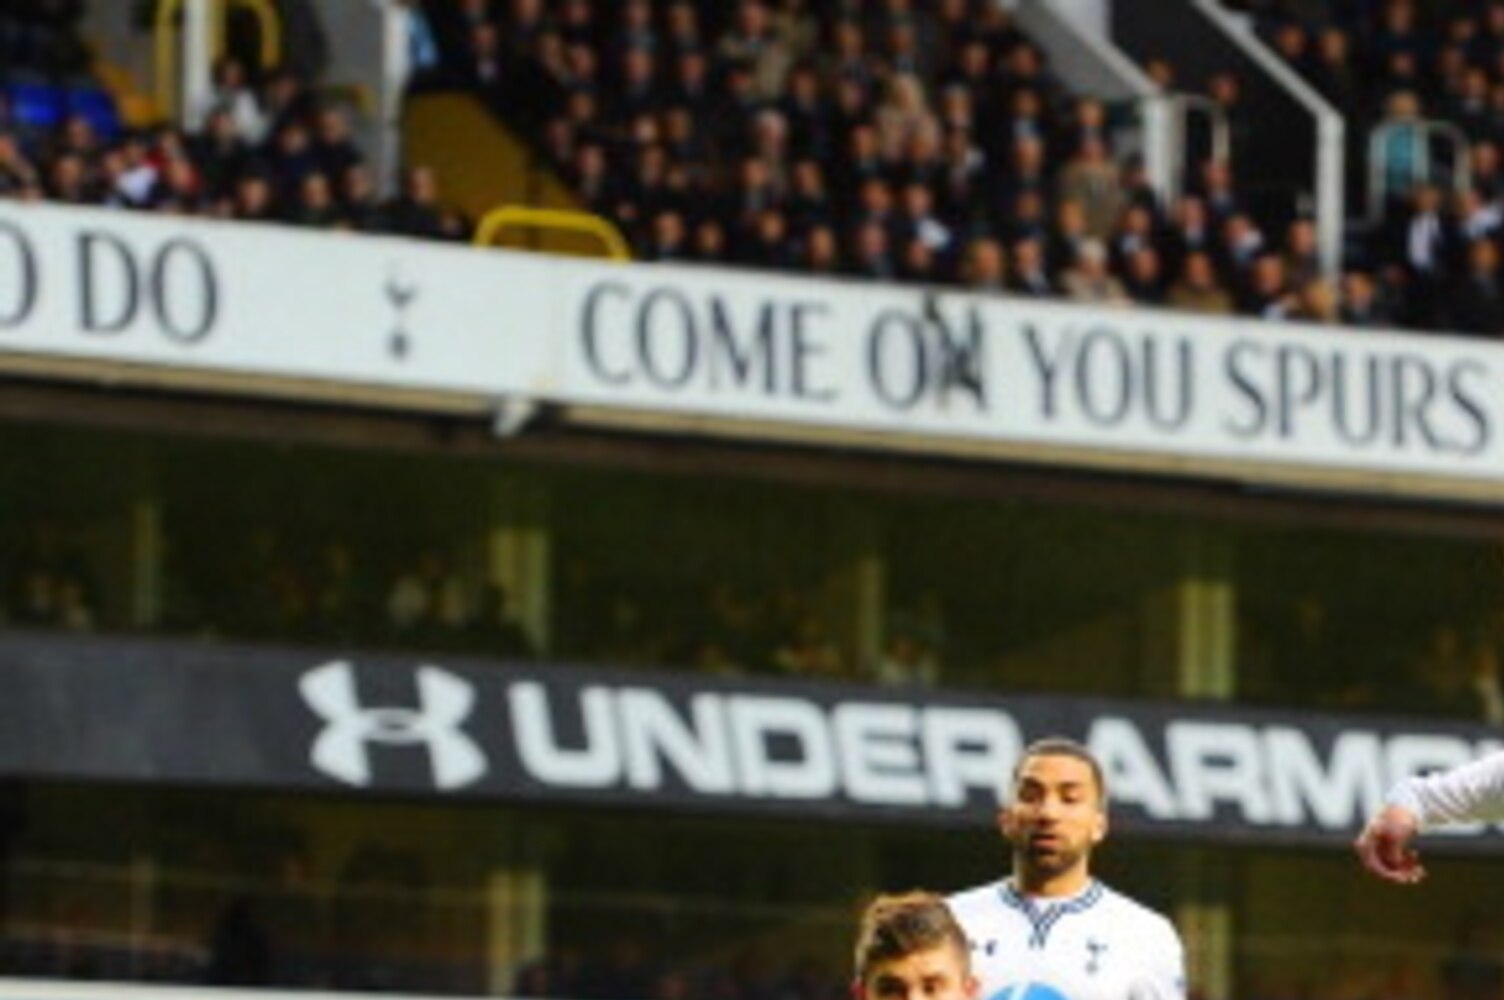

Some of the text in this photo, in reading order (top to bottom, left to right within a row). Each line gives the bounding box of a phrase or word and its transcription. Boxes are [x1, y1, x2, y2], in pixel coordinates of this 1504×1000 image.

[78, 230, 218, 346] DO
[580, 279, 842, 399] COME
[1020, 322, 1195, 431] YOU
[1222, 337, 1493, 456] SPURS
[508, 680, 1022, 807] UNDER
